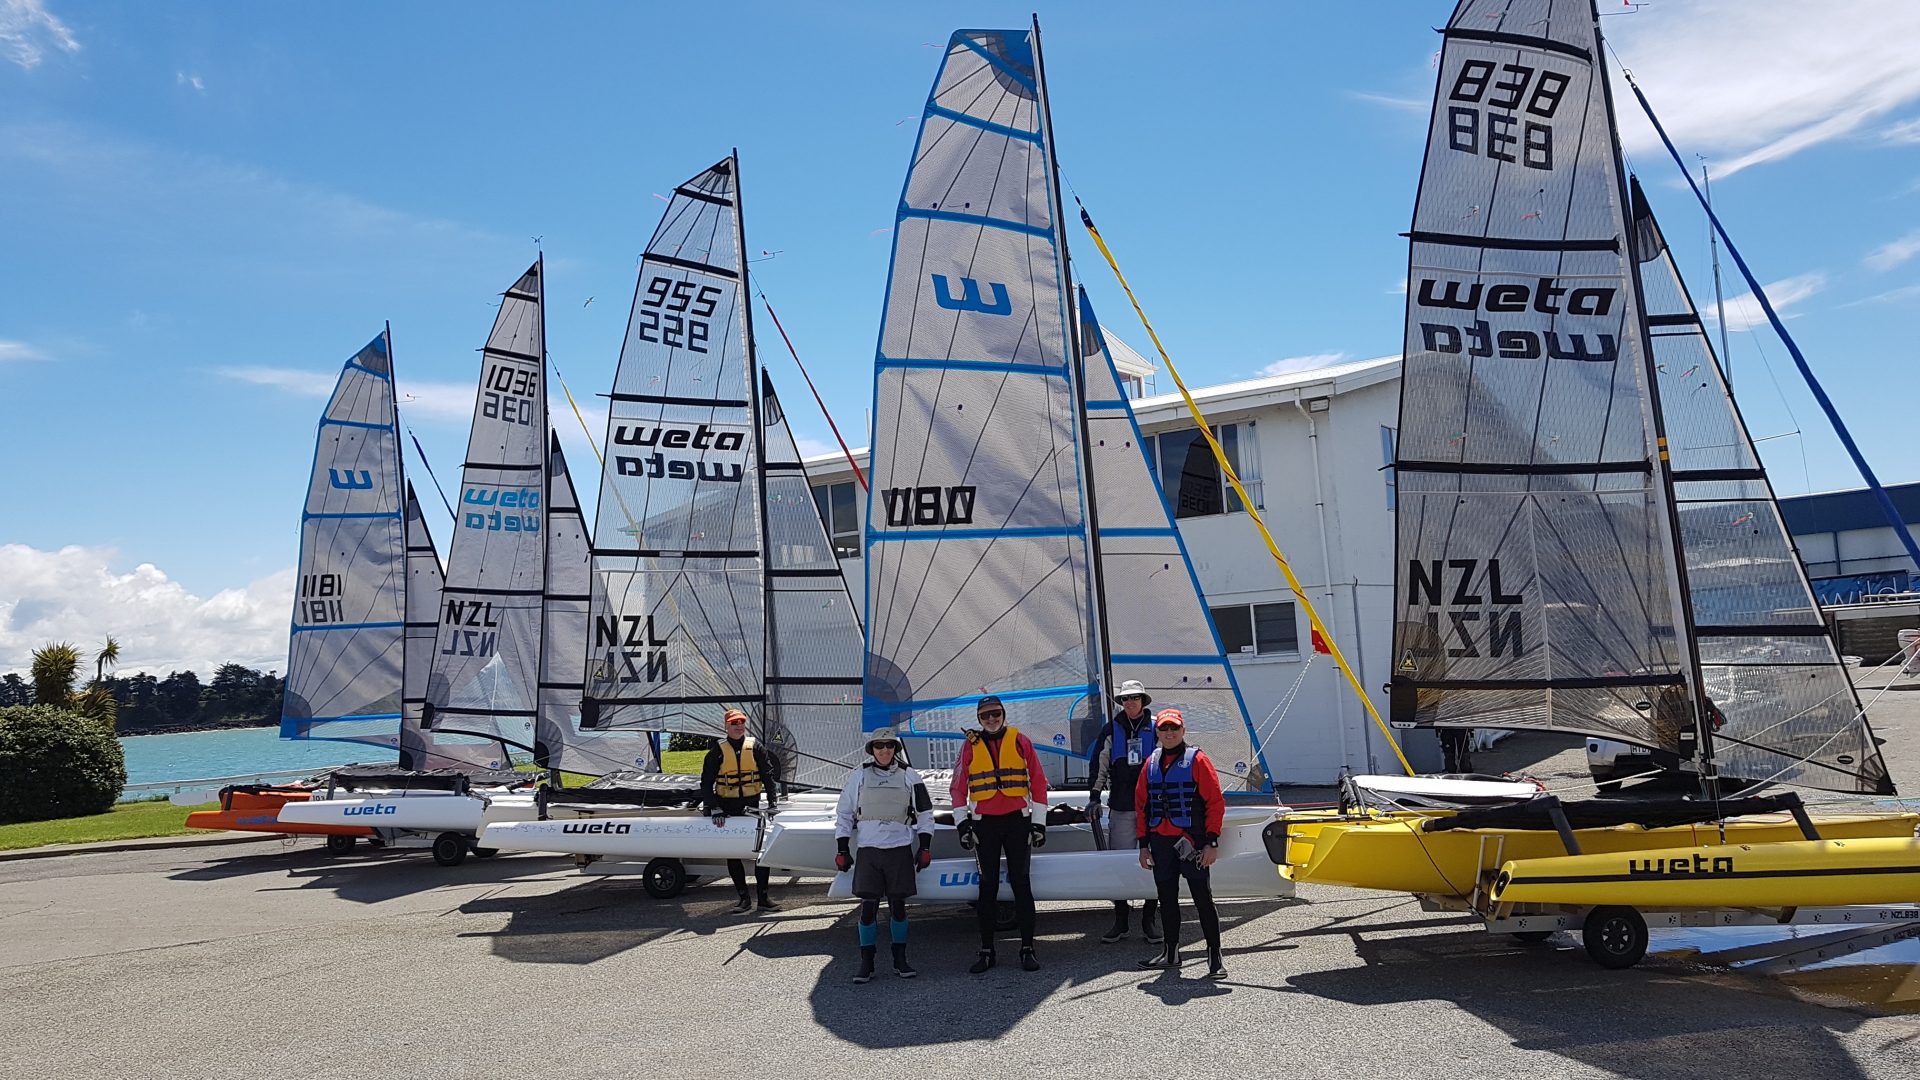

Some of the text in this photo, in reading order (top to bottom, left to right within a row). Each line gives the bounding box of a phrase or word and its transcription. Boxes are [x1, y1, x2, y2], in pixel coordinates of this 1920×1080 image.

[1449, 59, 1571, 118] 838
[642, 277, 722, 317] 955
[1417, 278, 1617, 316] weta
[486, 364, 538, 398] 1036
[614, 425, 745, 451] weta
[464, 488, 539, 508] weta
[302, 574, 341, 597] 1181
[1409, 559, 1523, 605] NZL
[446, 600, 498, 627] NZL
[596, 615, 668, 647] NZL
[344, 803, 397, 816] weta
[563, 821, 631, 835] weta
[1629, 854, 1734, 875] weta
